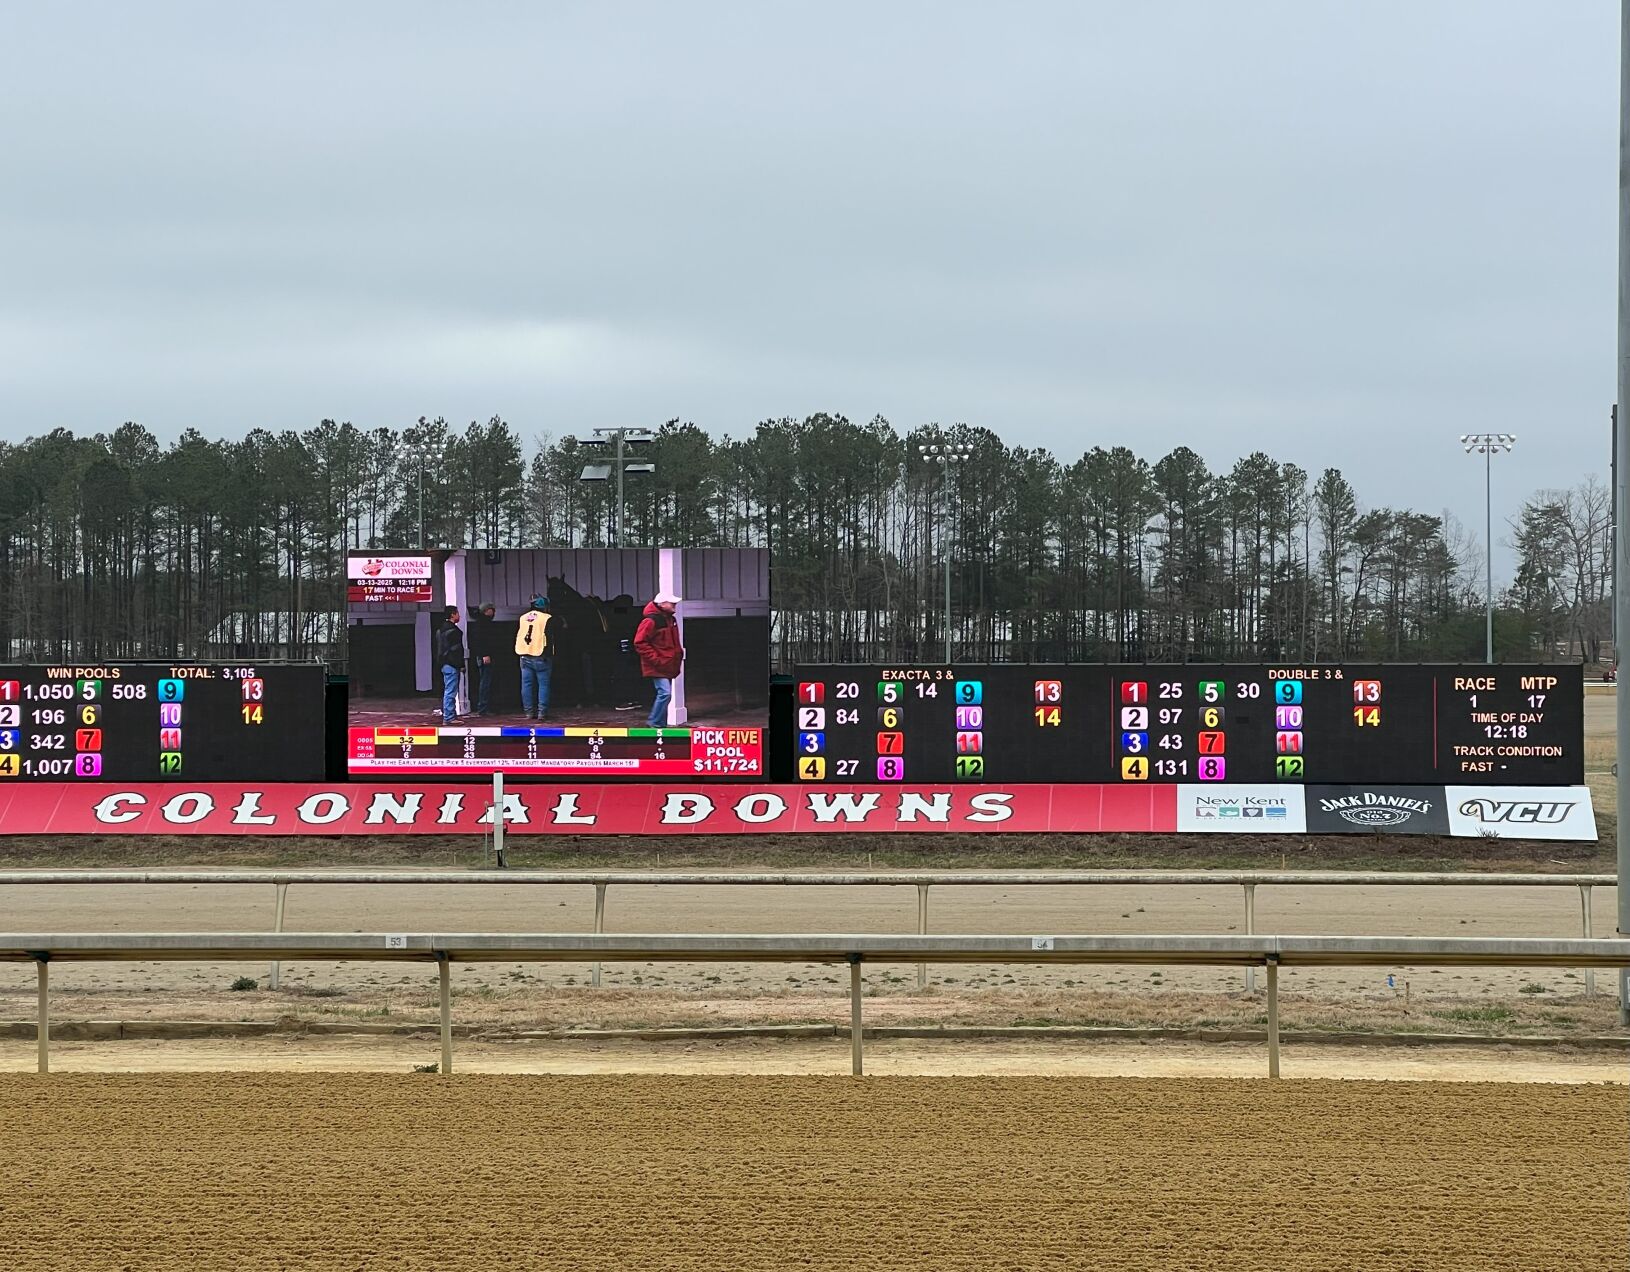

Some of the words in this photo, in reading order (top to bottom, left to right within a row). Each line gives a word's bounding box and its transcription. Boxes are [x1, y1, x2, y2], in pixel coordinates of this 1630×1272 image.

[47, 668, 72, 678] WIN
[76, 668, 120, 678] POOLS
[170, 668, 215, 678] TOTAL:
[223, 668, 255, 680] 3,105
[882, 670, 930, 680] EXACTA
[936, 670, 942, 680] 3
[946, 670, 954, 680] &
[1269, 670, 1319, 679] DOUBLE
[1325, 670, 1332, 679] 3
[1335, 670, 1343, 679] &
[1, 682, 11, 700] 1
[24, 685, 74, 701] 1,050
[82, 682, 96, 700] 5
[112, 685, 146, 699] 508
[164, 682, 176, 699] 9
[242, 681, 263, 698] 13
[1454, 678, 1496, 690] RACE
[1521, 677, 1558, 690] MTP
[806, 685, 816, 702] 1
[836, 683, 860, 698] 20
[883, 684, 897, 702] 5
[916, 683, 938, 698] 14
[962, 684, 975, 702] 9
[1035, 684, 1060, 702] 13
[1128, 684, 1138, 701] 1
[1159, 683, 1182, 698] 25
[1204, 684, 1218, 702] 5
[1237, 683, 1260, 698] 30
[1282, 684, 1295, 702] 9
[1354, 684, 1379, 701] 13
[1470, 695, 1477, 708] 1
[1528, 695, 1546, 708] 17
[1, 707, 12, 724] 2
[32, 710, 64, 724] 196
[82, 706, 96, 724] 6
[161, 706, 181, 724] 10
[242, 706, 263, 724] 14
[805, 710, 818, 727] 2
[836, 708, 860, 724] 84
[883, 709, 897, 728] 6
[957, 708, 981, 726] 10
[1035, 709, 1061, 727] 14
[1128, 710, 1141, 727] 2
[1159, 708, 1182, 724] 97
[1205, 709, 1218, 727] 6
[1277, 708, 1301, 726] 10
[1354, 709, 1380, 726] 14
[1471, 713, 1498, 722] TIME
[1501, 713, 1517, 722] OF
[1520, 713, 1544, 722] DAY
[693, 730, 725, 744] PICK
[728, 730, 758, 744] FIVE
[1484, 725, 1527, 738] 12:18
[1, 731, 12, 749] 3
[30, 735, 65, 750] 342
[82, 731, 94, 749] 7
[161, 731, 180, 748] 11
[805, 734, 818, 752] 3
[884, 734, 896, 752] 7
[958, 734, 979, 752] 11
[1128, 734, 1141, 752] 3
[1159, 735, 1182, 750] 43
[1205, 734, 1217, 752] 7
[1278, 734, 1299, 752] 11
[706, 747, 744, 757] POOL
[1454, 746, 1494, 756] TRACK
[1498, 746, 1562, 756] CONDITION
[0, 756, 12, 774] 4
[23, 760, 73, 776] 1,007
[82, 756, 94, 774] 8
[161, 755, 180, 772] 12
[694, 759, 758, 771] $11,724
[805, 760, 819, 777] 4
[836, 760, 860, 775] 27
[883, 760, 897, 777] 8
[957, 760, 981, 776] 12
[1128, 760, 1141, 777] 4
[1155, 760, 1187, 775] 131
[1205, 759, 1218, 777] 8
[1277, 760, 1301, 776] 12
[1462, 762, 1494, 771] FAST
[94, 792, 597, 824] COLONIAL
[660, 792, 1014, 824] DOWNS
[1196, 797, 1239, 805] New
[1245, 797, 1286, 805] Kent
[1460, 799, 1576, 823] VCU
[390, 938, 400, 946] 53
